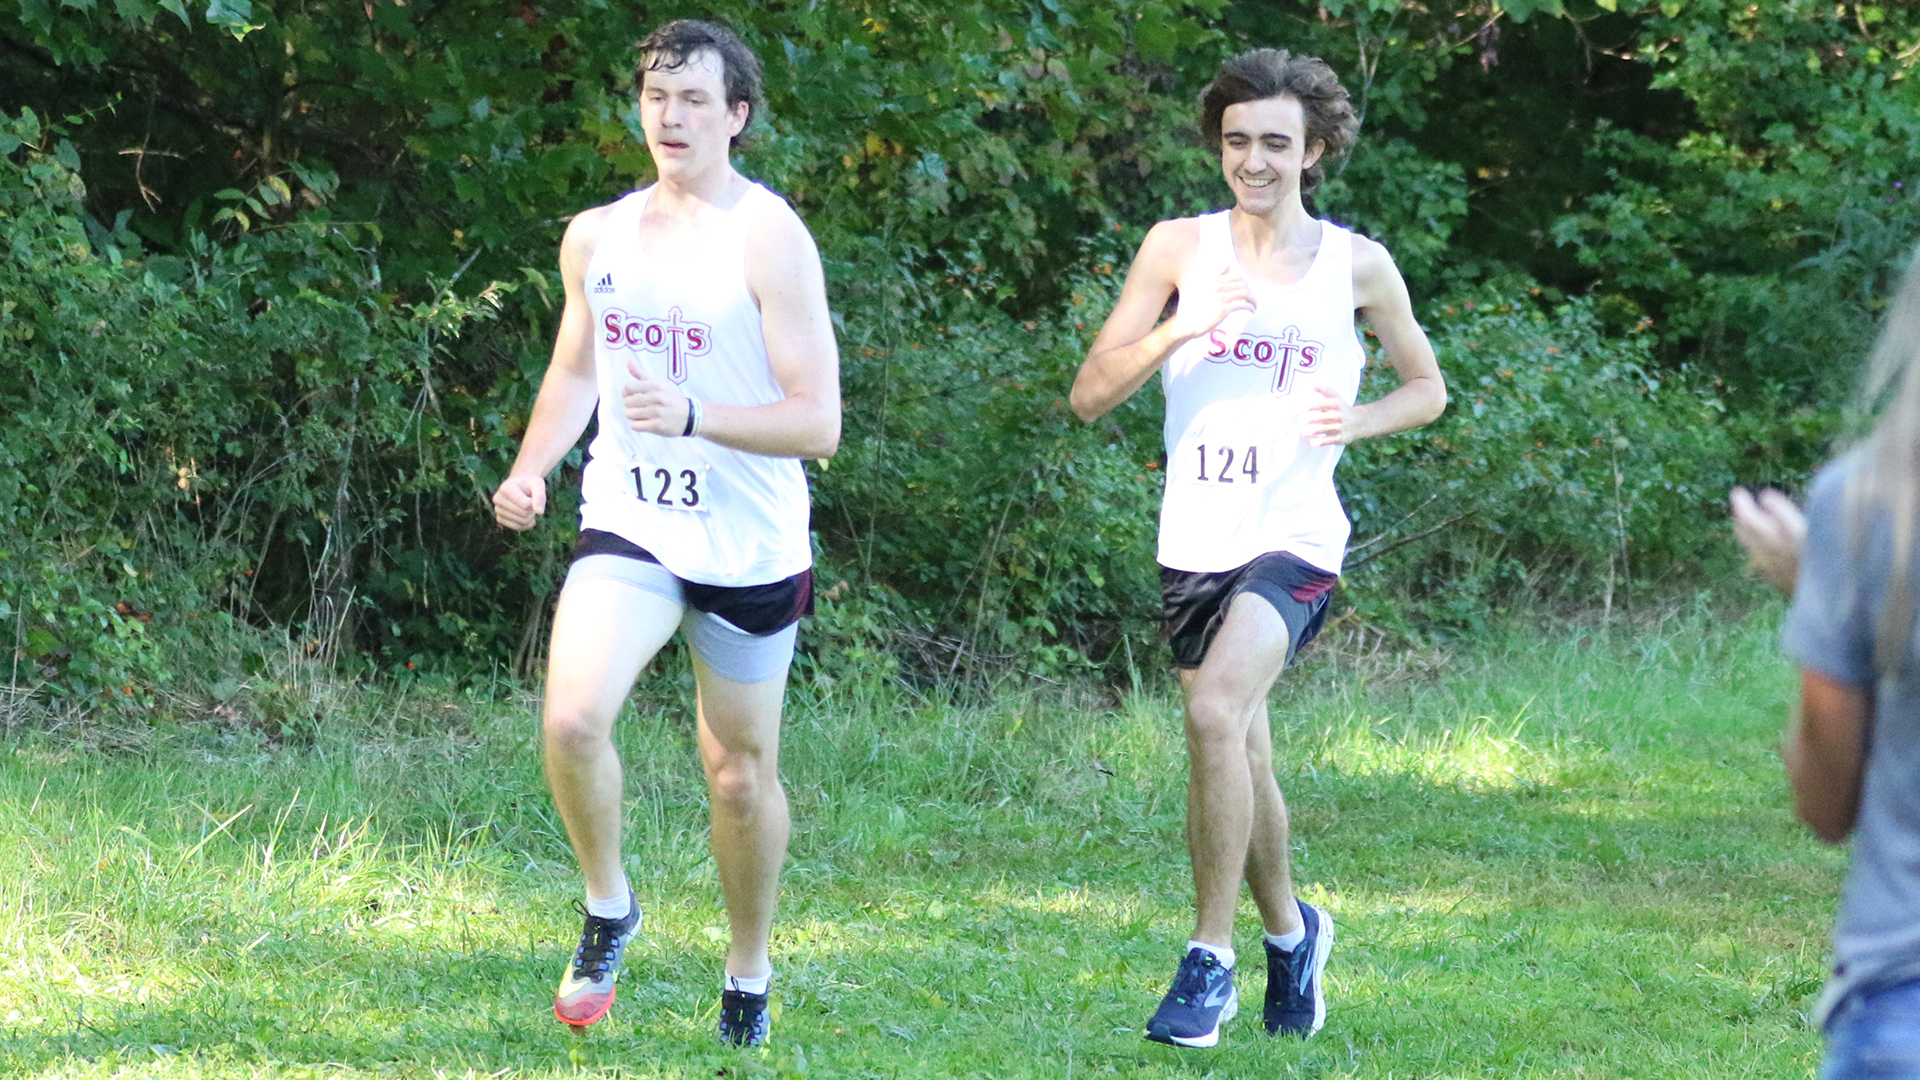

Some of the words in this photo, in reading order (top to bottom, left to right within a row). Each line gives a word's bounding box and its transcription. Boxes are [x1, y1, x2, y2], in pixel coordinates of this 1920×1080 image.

[594, 285, 615, 293] adidas
[1196, 443, 1260, 484] 124
[630, 466, 700, 507] 123
